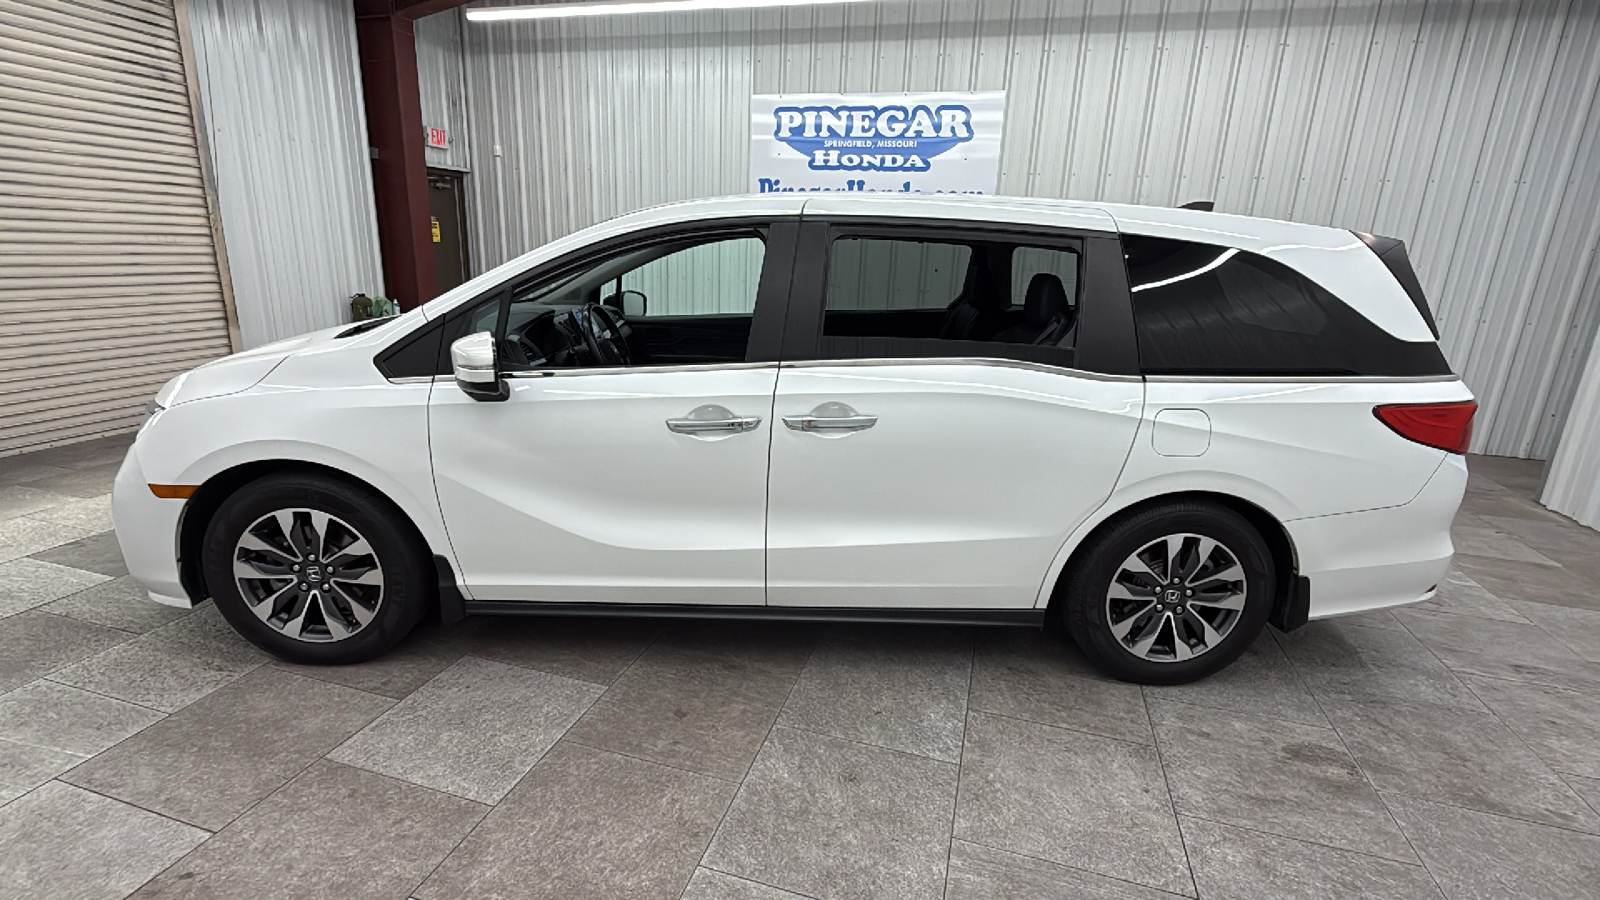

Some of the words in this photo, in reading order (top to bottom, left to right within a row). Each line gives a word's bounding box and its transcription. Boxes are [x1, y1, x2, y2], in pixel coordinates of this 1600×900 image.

[777, 109, 970, 138] PINEGAR
[431, 128, 446, 146] EXIT
[824, 140, 875, 148] SPRINGFIELD,
[876, 140, 918, 148] MISSOURI
[813, 150, 926, 167] HONDA
